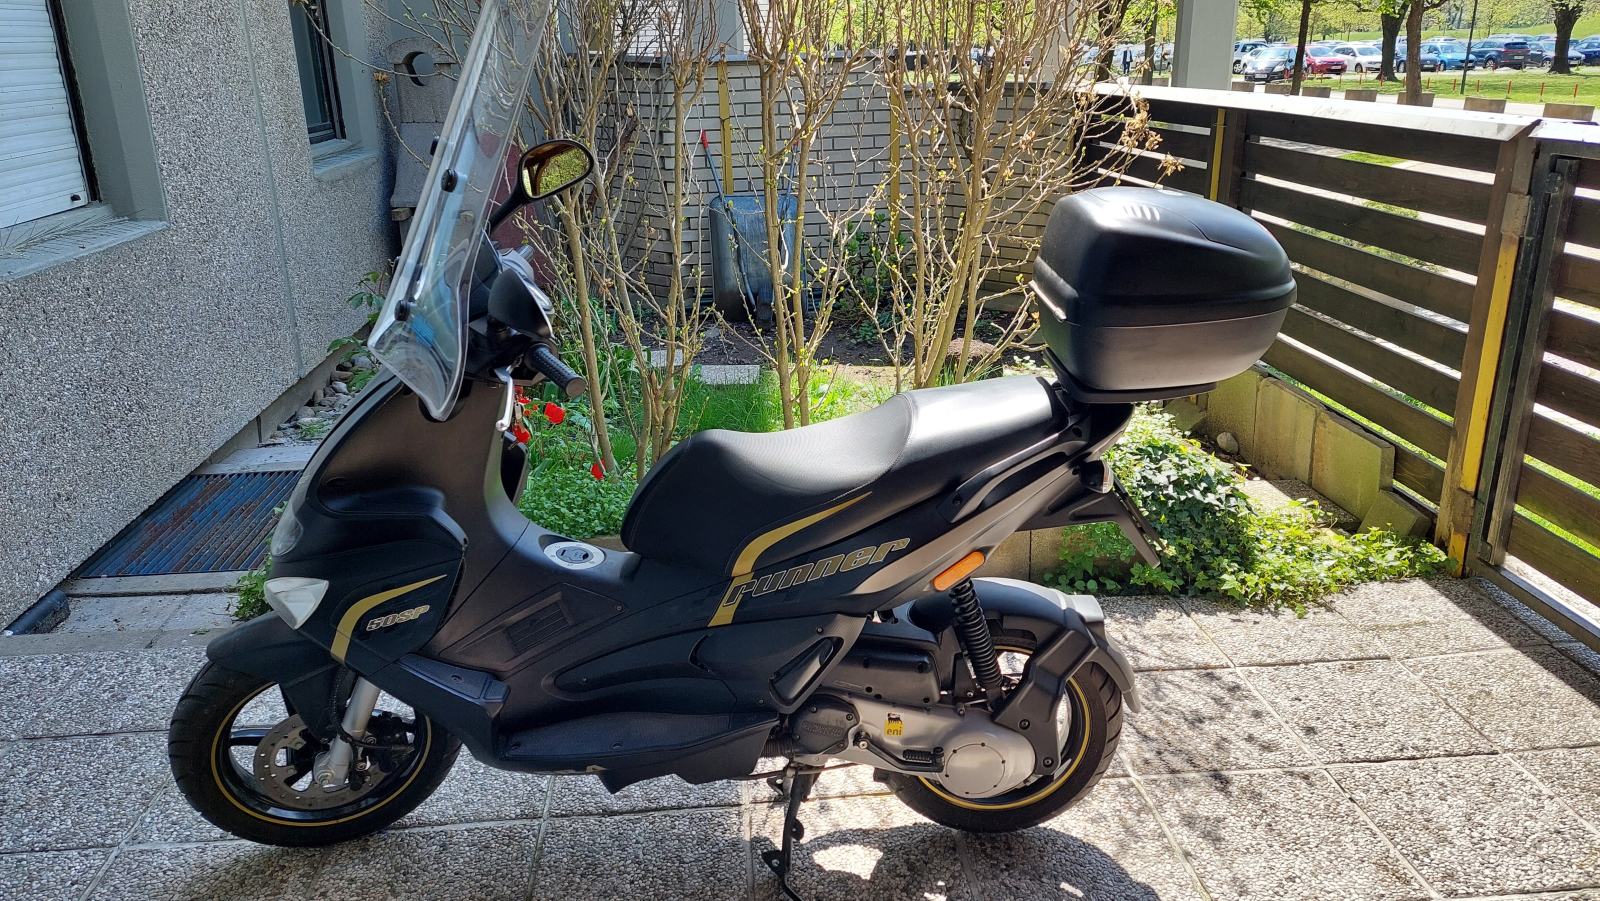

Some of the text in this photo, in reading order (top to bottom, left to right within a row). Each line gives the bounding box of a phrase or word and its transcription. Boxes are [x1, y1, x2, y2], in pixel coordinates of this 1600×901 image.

[723, 538, 911, 607] runner
[366, 604, 430, 631] 50SP
[887, 726, 902, 736] eni
